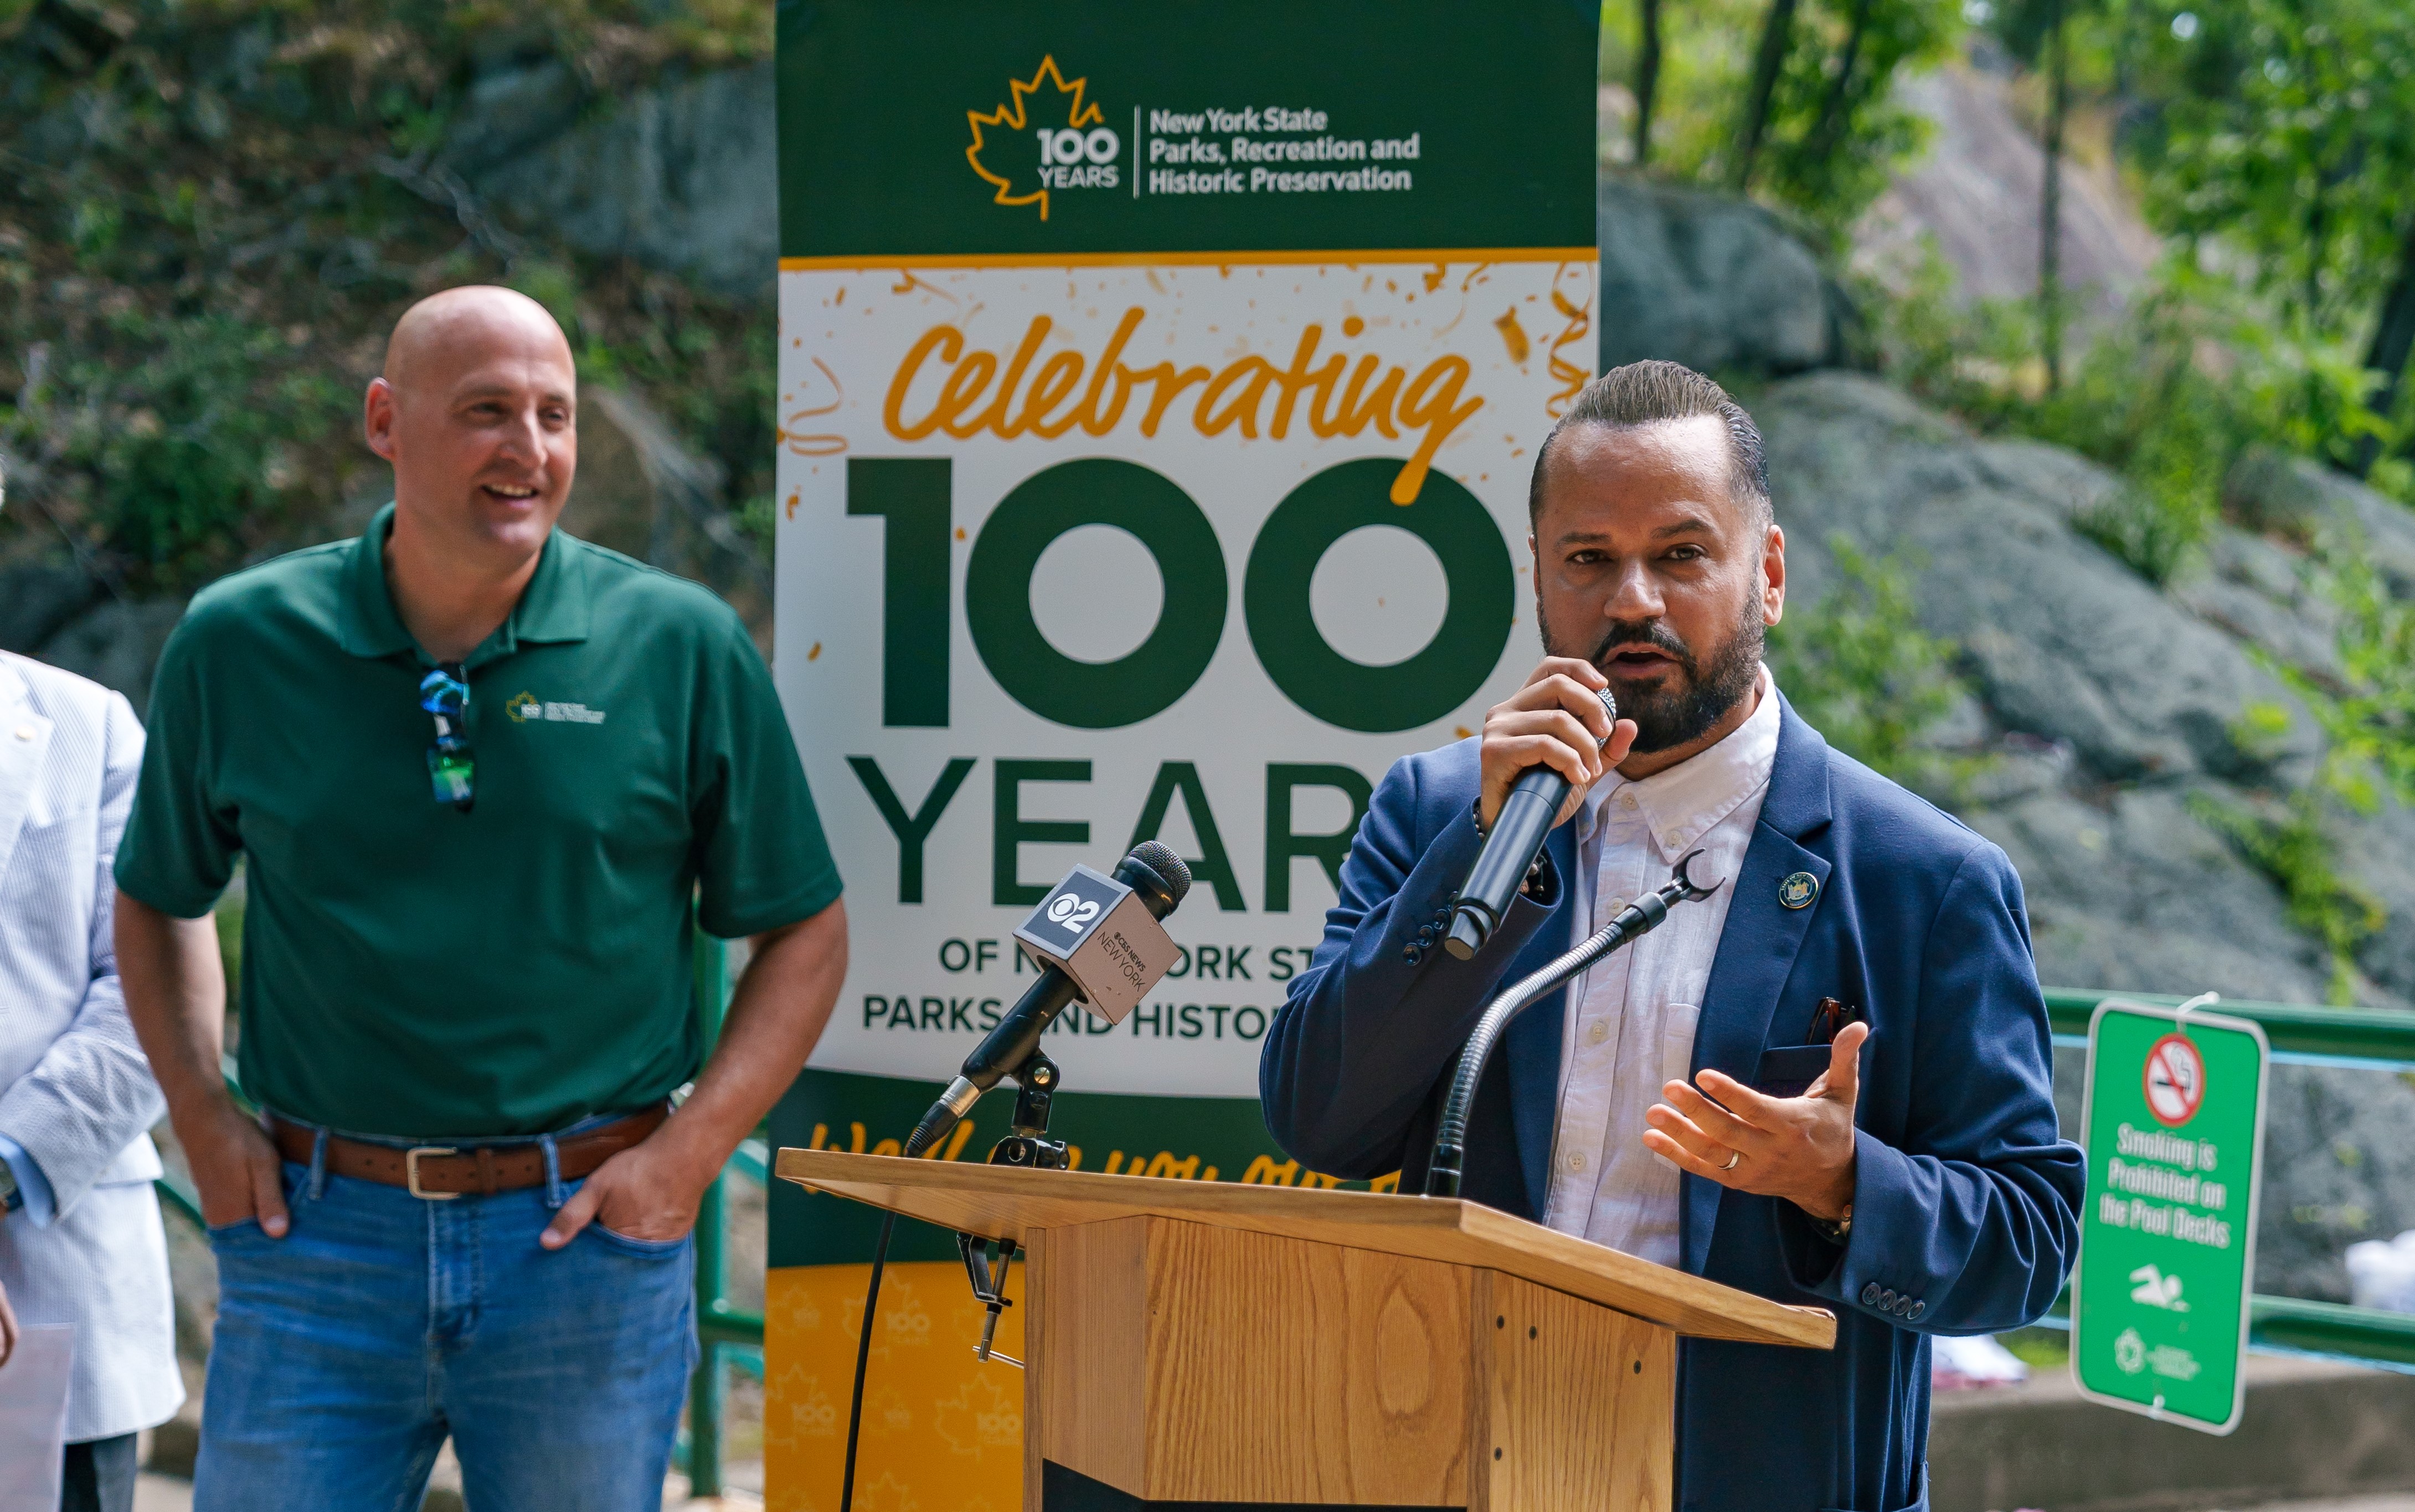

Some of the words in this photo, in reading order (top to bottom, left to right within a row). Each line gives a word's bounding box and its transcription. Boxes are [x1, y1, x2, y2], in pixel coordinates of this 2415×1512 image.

[1150, 109, 1205, 134] New
[1206, 106, 1261, 133] York
[1263, 105, 1328, 132] State
[1037, 127, 1120, 166] 100
[1149, 136, 1227, 166] Parks,
[1232, 135, 1367, 162] Recreation
[1370, 131, 1420, 160] and
[1037, 166, 1119, 189] YEARS
[1149, 167, 1245, 194] Historic
[1250, 164, 1413, 193] Preservation
[883, 306, 1486, 506] Celebrating
[846, 456, 1516, 734] 100
[845, 756, 1376, 914] YEAR
[940, 938, 997, 973] OF
[1166, 943, 1252, 981] ORK
[1097, 931, 1123, 961] NEW
[1119, 956, 1146, 993] YORK
[1119, 937, 1131, 952] CBS
[1127, 949, 1146, 972] NEWS
[863, 995, 1002, 1033] PARKS
[1132, 1003, 1281, 1040] HISTO
[2117, 1122, 2197, 1172] Smoking
[2197, 1137, 2217, 1172] is
[2108, 1157, 2201, 1205] Prohibited
[2200, 1181, 2227, 1211] on
[2099, 1192, 2129, 1227] the
[2129, 1198, 2172, 1236] Pool
[2172, 1206, 2231, 1250] Decks
